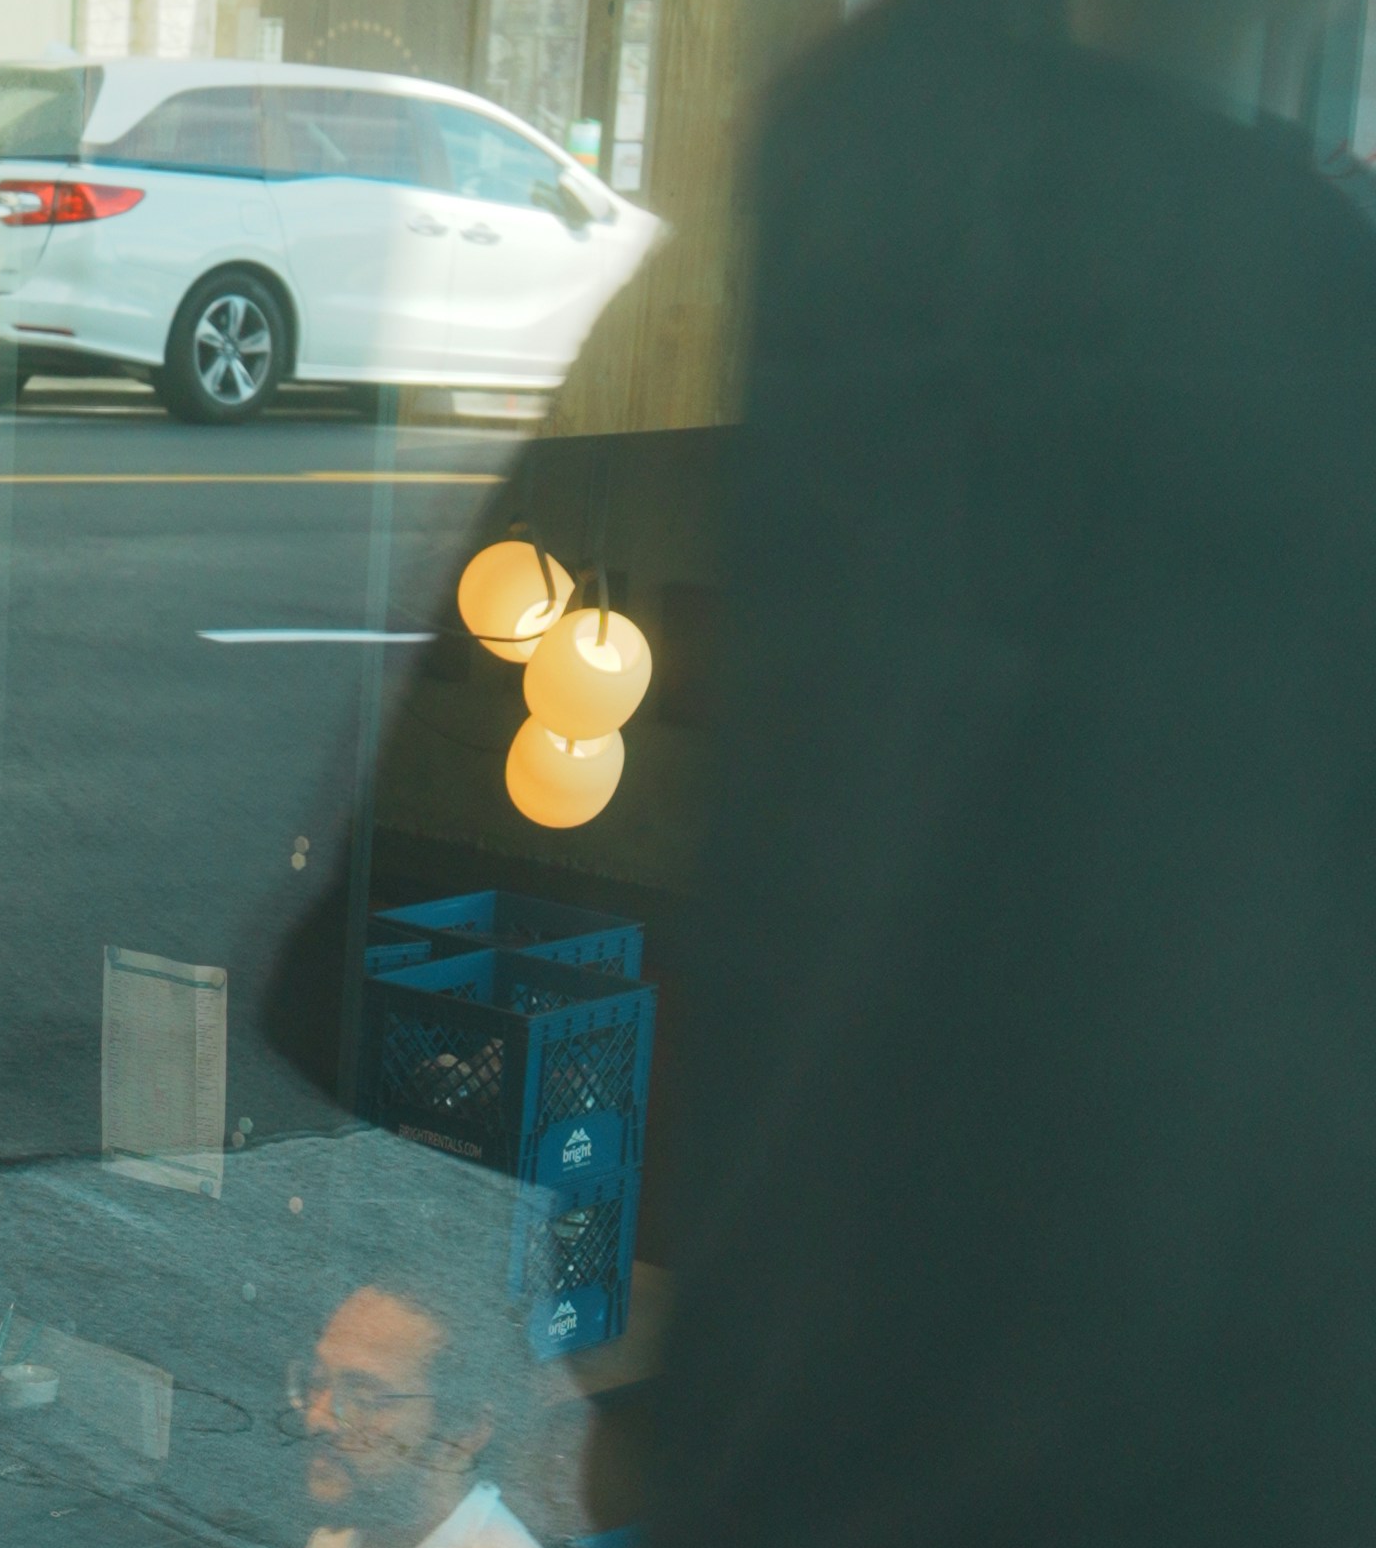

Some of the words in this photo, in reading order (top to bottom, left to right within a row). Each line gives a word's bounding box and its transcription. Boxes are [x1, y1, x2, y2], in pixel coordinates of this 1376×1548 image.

[399, 1124, 482, 1159] BRIGHTRENTALS.COM
[563, 1142, 592, 1163] bright
[548, 1314, 577, 1335] bright
